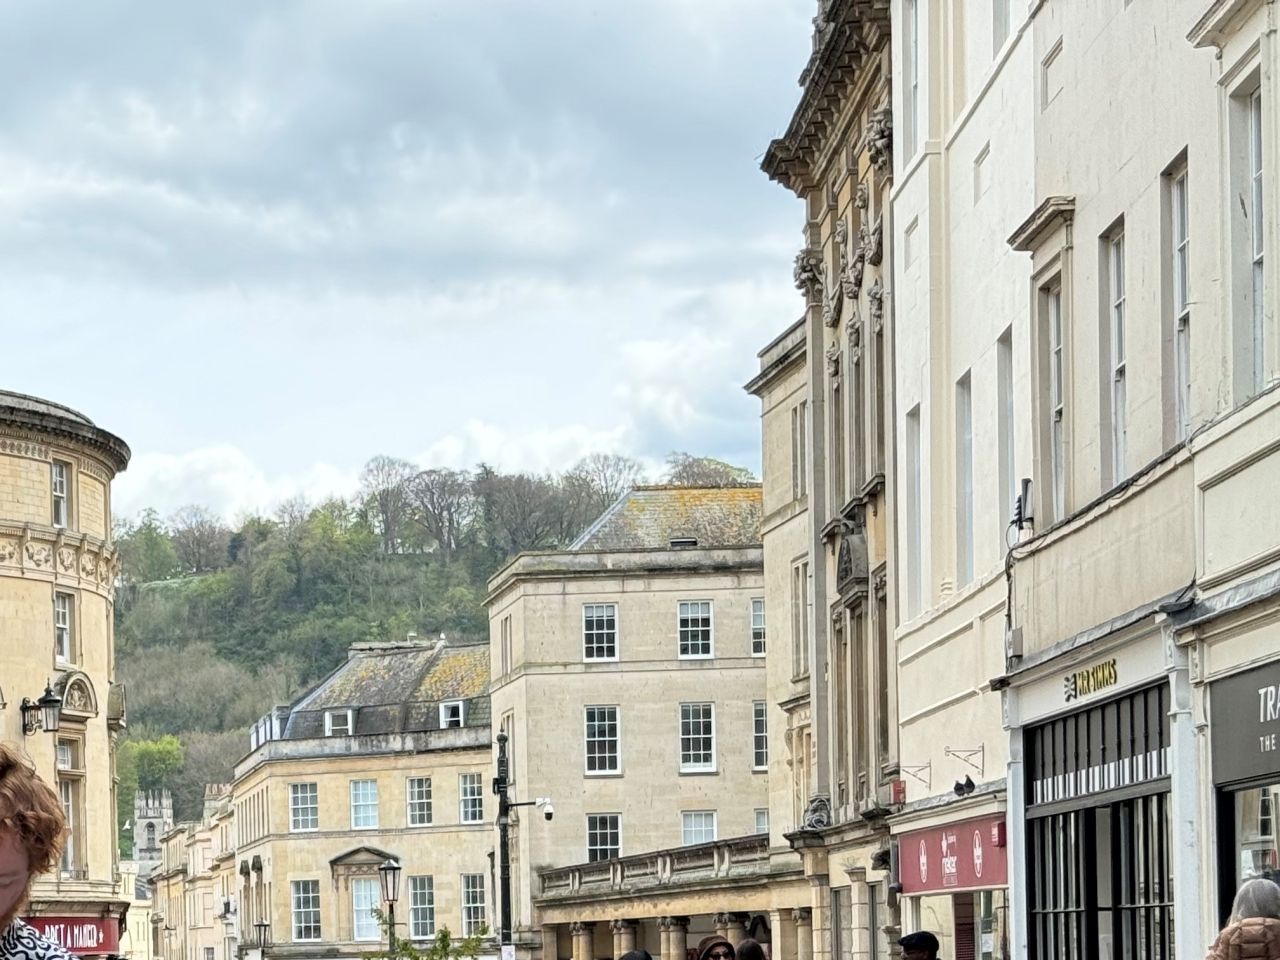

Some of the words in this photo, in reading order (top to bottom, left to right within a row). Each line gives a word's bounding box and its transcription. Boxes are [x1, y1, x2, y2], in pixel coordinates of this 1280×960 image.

[1091, 658, 1117, 692] SIMMS
[1260, 733, 1276, 753] THE
[66, 924, 72, 948] A
